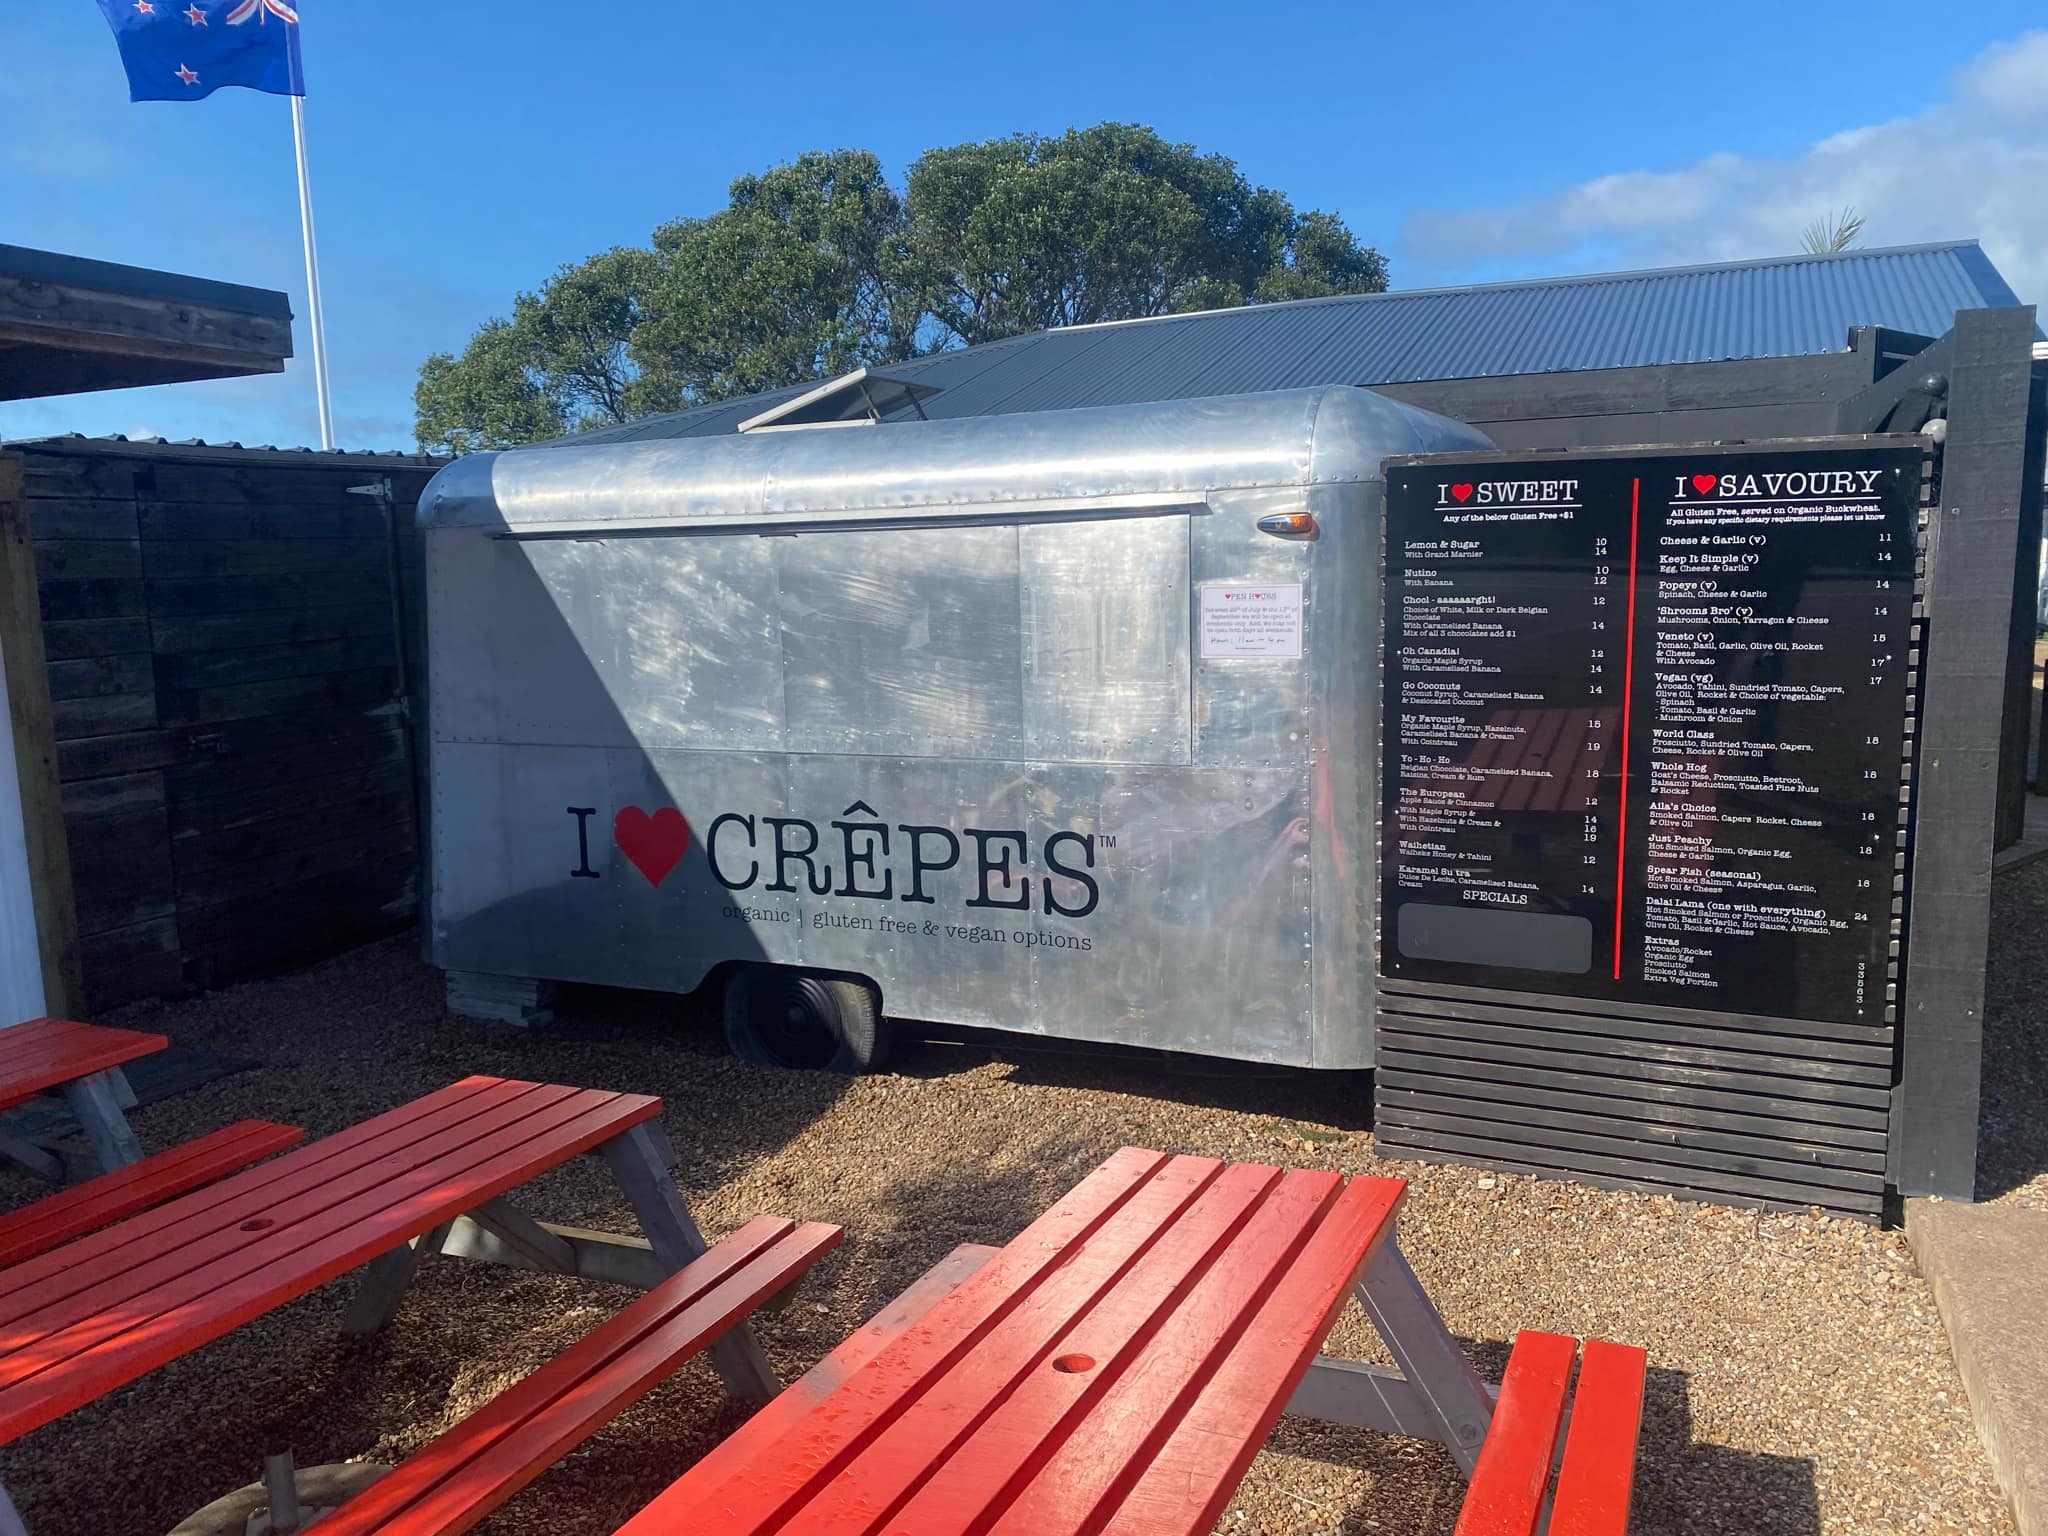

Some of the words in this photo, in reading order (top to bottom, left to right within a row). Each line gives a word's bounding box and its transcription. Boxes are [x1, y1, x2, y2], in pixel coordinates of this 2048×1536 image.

[1675, 477, 1687, 497] I
[1719, 470, 1882, 497] SAVOURY
[1437, 484, 1448, 504] I
[1477, 480, 1578, 503] SWEET
[1671, 509, 1683, 517] All
[1717, 508, 1739, 516] Free,
[1788, 506, 1823, 515] Organic
[1486, 513, 1507, 521] below
[1596, 538, 1607, 546] 10
[1660, 536, 1697, 545] Cheese
[1700, 536, 1709, 544] &
[1713, 536, 1746, 544] Garlic
[1749, 535, 1766, 545] (v)
[1880, 534, 1891, 542] 11
[1405, 541, 1437, 549] Lemon
[1451, 541, 1479, 549] Sugar
[1660, 555, 1686, 564] Keep
[1689, 555, 1698, 563] It
[1701, 555, 1738, 564] Simple
[1741, 554, 1759, 564] (v)
[1878, 553, 1891, 561] 14
[1405, 569, 1437, 577] Nutino
[1659, 581, 1697, 590] Popeye
[1700, 581, 1717, 591] (v)
[1876, 581, 1889, 589] 14
[1659, 591, 1695, 599] Spinach,
[1740, 590, 1767, 598] Garlic
[1593, 597, 1605, 605] 12
[1736, 606, 1753, 617] (v)
[1874, 608, 1887, 616] 14
[1657, 617, 1710, 625] Mushrooms,
[1743, 617, 1784, 625] Tarragon
[1658, 632, 1694, 641] Veneto
[1697, 632, 1714, 642] (v)
[1873, 634, 1886, 642] 15
[1591, 650, 1604, 658] 12
[1872, 659, 1884, 667] 17
[1590, 665, 1602, 673] 14
[1655, 673, 1687, 682] Vegan
[1690, 673, 1713, 683] (vg)
[1870, 677, 1882, 685] 17
[1403, 682, 1414, 690] Go
[1417, 682, 1461, 690] Coconuts
[1590, 686, 1602, 694] 14
[1401, 715, 1416, 723] My
[1419, 715, 1465, 724] Favourite
[1588, 720, 1600, 728] 15
[1653, 730, 1684, 739] World
[1687, 730, 1714, 739] Class
[1866, 736, 1878, 745] 18
[1587, 743, 1600, 751] 19
[1401, 755, 1412, 763] Yo
[1652, 762, 1683, 771] Whole
[1686, 763, 1707, 773] Hog
[1586, 770, 1599, 778] 18
[1864, 770, 1876, 779] 18
[1400, 788, 1417, 796] The
[1420, 789, 1465, 798] European
[1586, 798, 1597, 806] 12
[1681, 804, 1716, 813] Choice
[1585, 816, 1597, 824] 14
[1861, 813, 1874, 821] 18
[1584, 825, 1596, 833] 16
[1584, 834, 1596, 842] 19
[1648, 835, 1671, 843] Just
[1674, 836, 1712, 846] Peachy
[567, 807, 600, 878] I
[1399, 841, 1446, 851] Waihetian
[1859, 847, 1872, 855] 18
[1584, 856, 1596, 864] 12
[1399, 865, 1438, 875] Karamel
[1647, 866, 1677, 874] Spear
[1680, 867, 1702, 876] Fish
[1705, 868, 1761, 881] (seasonal)
[1857, 880, 1870, 888] 18
[1582, 885, 1594, 893] 14
[1463, 890, 1527, 905] SPECIALS
[1646, 897, 1673, 906] Dalai
[1676, 898, 1704, 908] Lama
[1707, 900, 1731, 911] (one
[1734, 903, 1757, 913] with
[1760, 905, 1826, 919] everything)
[1854, 913, 1867, 921] 24
[722, 903, 790, 923] organic
[813, 909, 873, 931] gluten
[878, 915, 917, 934] free
[922, 920, 940, 936] &
[945, 923, 1006, 945] vegan
[1013, 926, 1092, 951] options
[1644, 936, 1680, 945] Extras
[1645, 945, 1712, 956] Avocado/Rocket
[1644, 959, 1687, 969] Prosciutto
[1644, 974, 1667, 982] Extra
[1670, 976, 1685, 985] Veg
[1687, 978, 1718, 987] Portion
